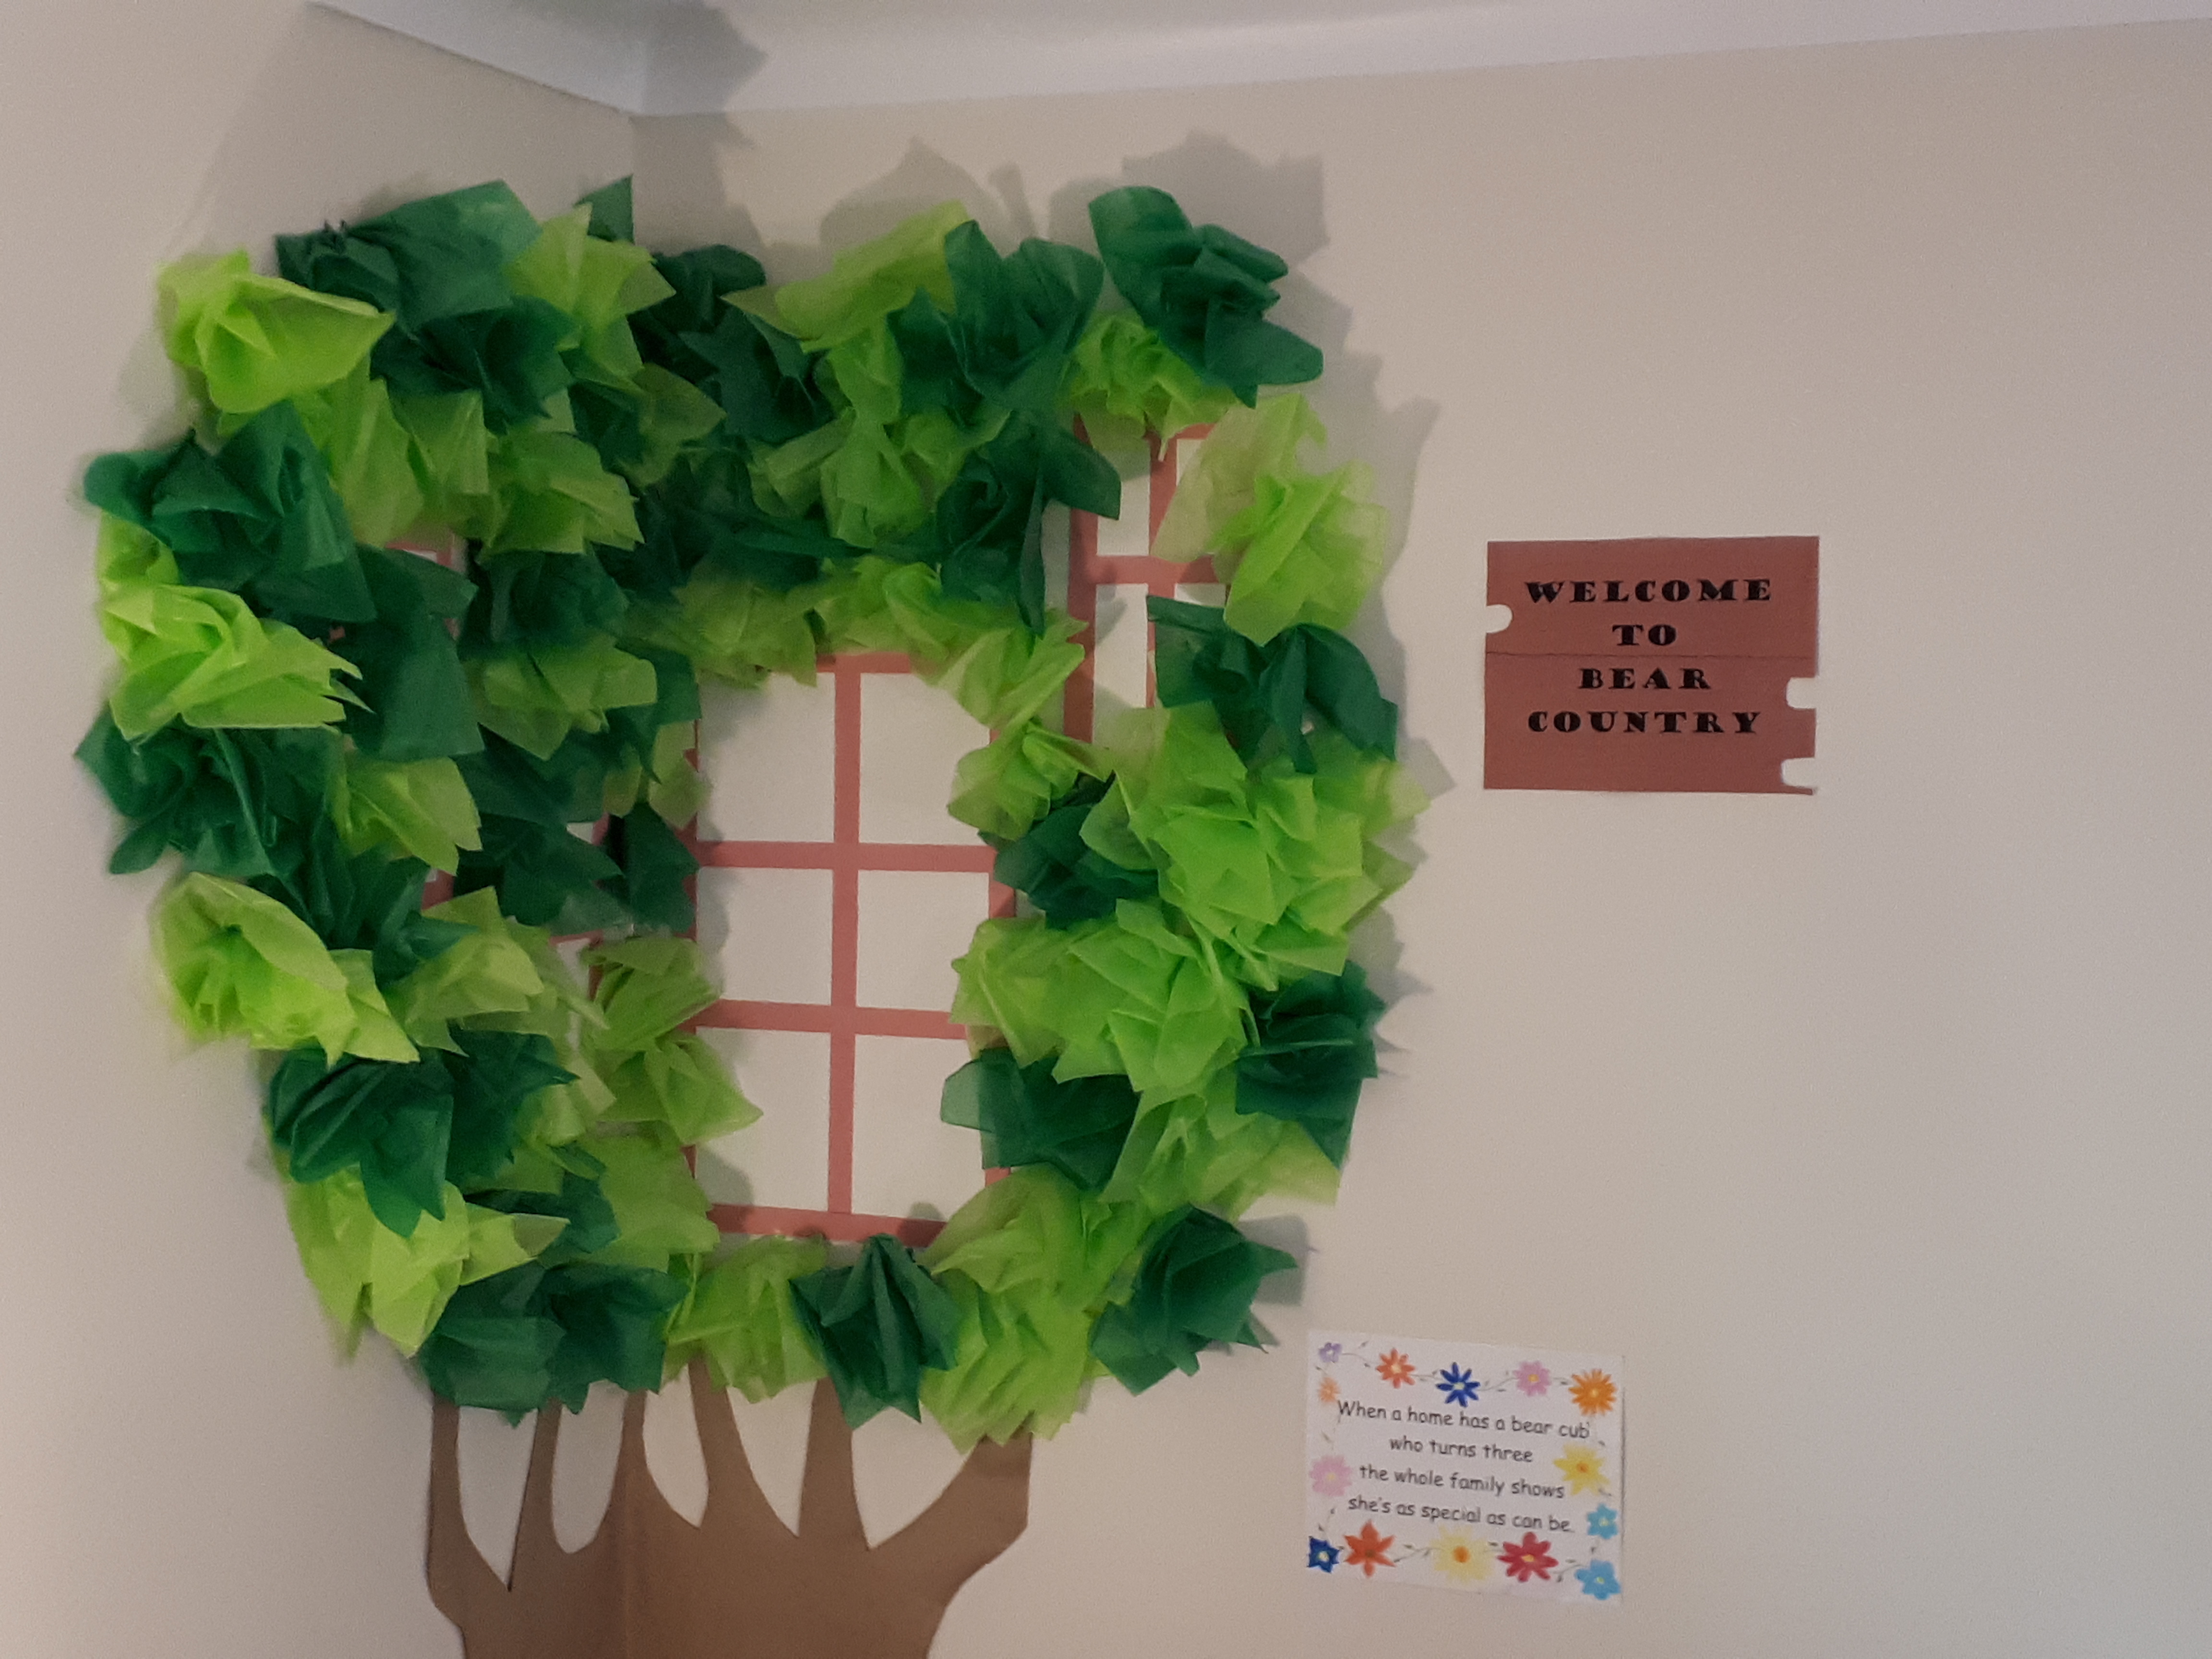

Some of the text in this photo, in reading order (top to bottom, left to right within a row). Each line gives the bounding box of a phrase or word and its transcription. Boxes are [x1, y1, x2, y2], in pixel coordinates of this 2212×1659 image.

[1525, 579, 1771, 603] WELCOME
[1612, 624, 1677, 646] TO
[1578, 668, 1711, 689] BEAR
[1527, 711, 1761, 733] COUNTRY
[1338, 1400, 1590, 1439] When a home has a bear cub
[1389, 1435, 1534, 1463] who turns three
[1359, 1464, 1565, 1498] the whole family shows
[1348, 1494, 1391, 1514] she's
[1396, 1504, 1415, 1516] as
[1421, 1504, 1481, 1523] special
[1487, 1512, 1506, 1526] as
[1512, 1515, 1542, 1528] can
